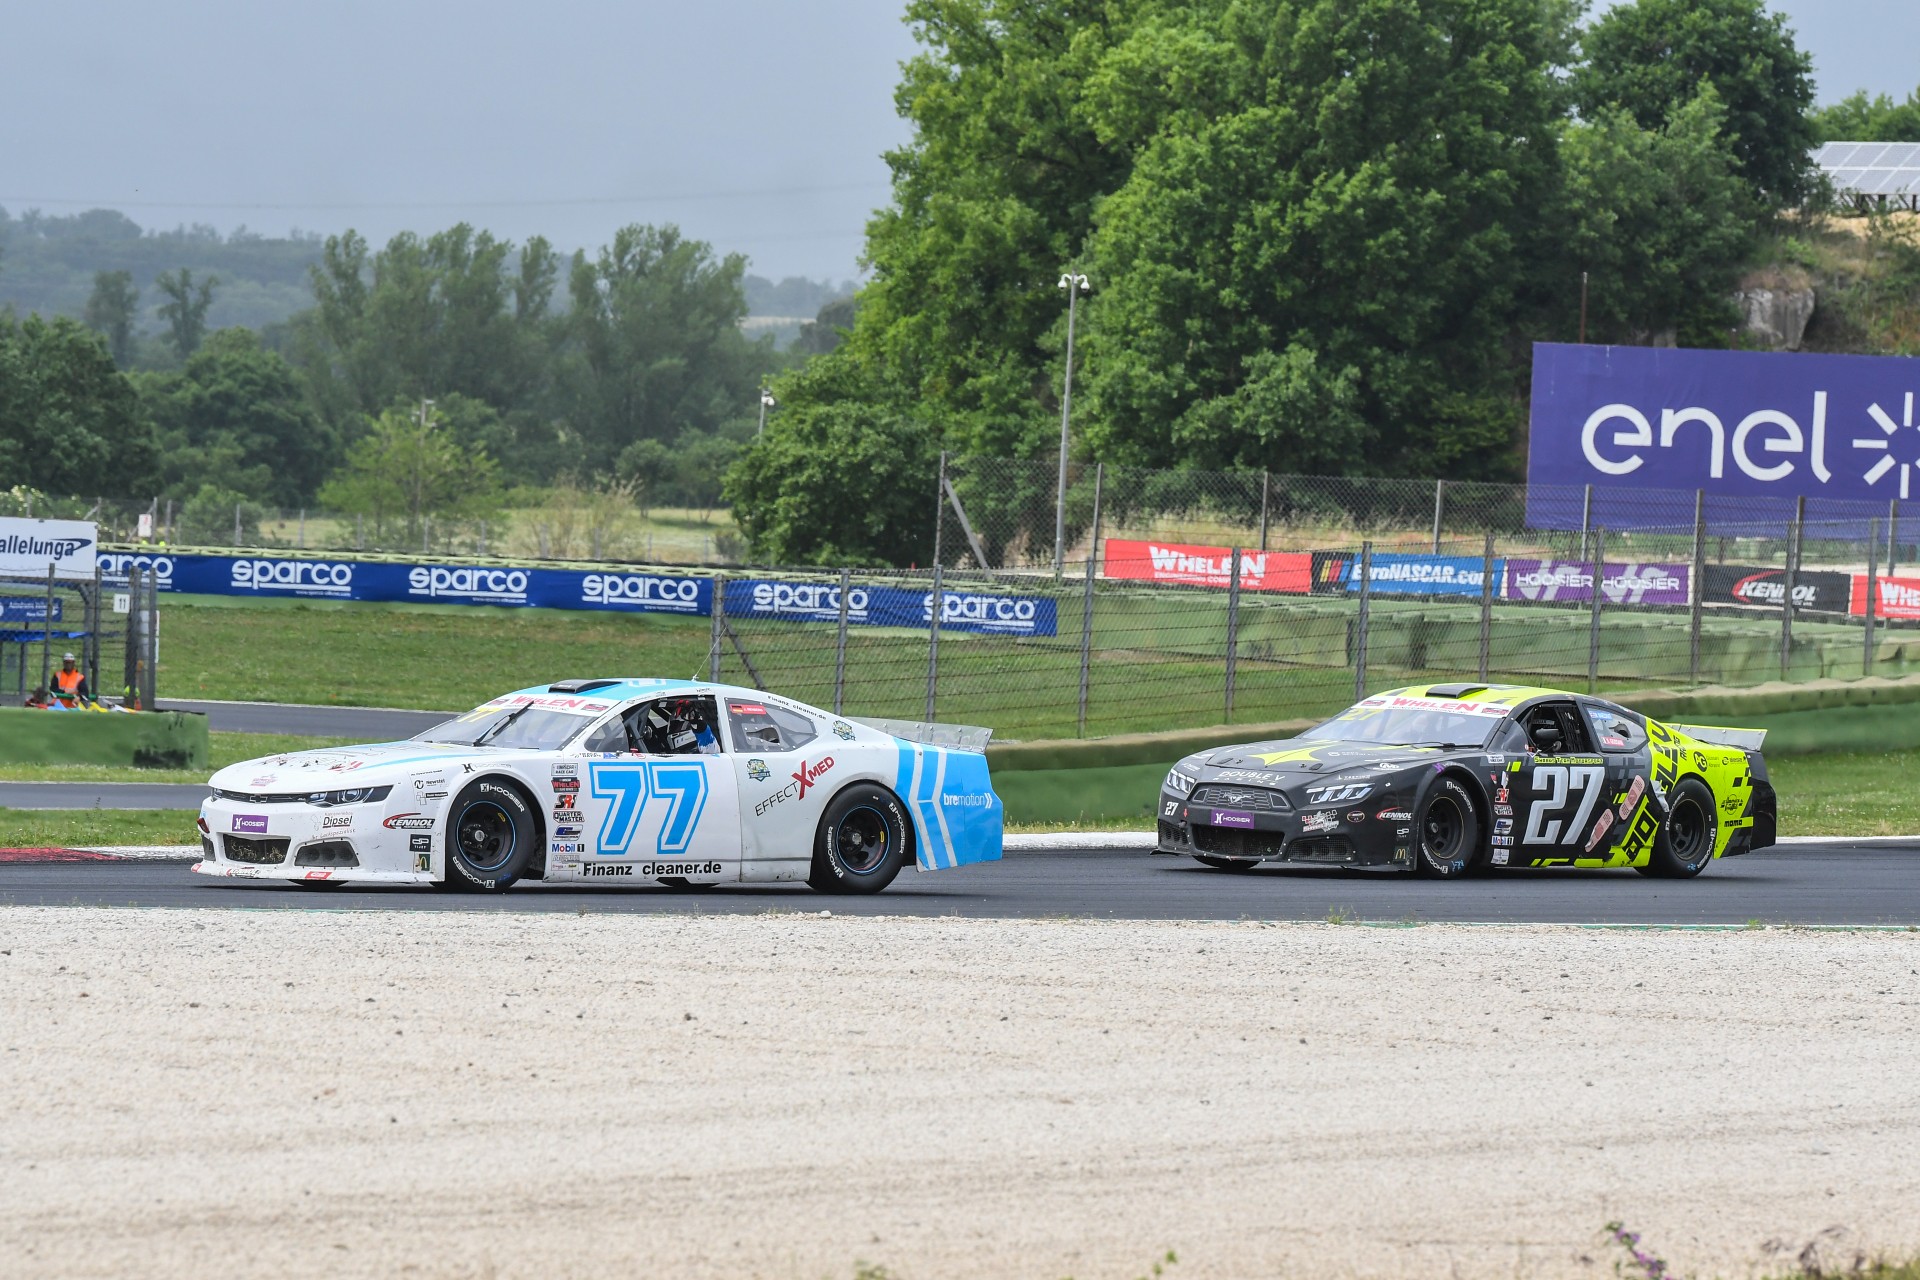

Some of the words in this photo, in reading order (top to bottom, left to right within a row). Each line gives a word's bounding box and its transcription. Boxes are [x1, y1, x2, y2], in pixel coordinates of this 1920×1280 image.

[1581, 391, 1832, 484] enel
[231, 560, 352, 589] sparco
[1149, 546, 1266, 578] WHELEN
[409, 567, 528, 596] sparco
[582, 574, 699, 604] sparco
[1516, 573, 1594, 588] HOOSIER
[1602, 575, 1680, 590] HOOSIER
[1738, 581, 1817, 601] KENOL
[752, 583, 869, 613] sparco
[922, 591, 1036, 623] sparco
[1392, 698, 1479, 711] WHELEN
[489, 785, 525, 813] HOOSIER
[588, 762, 709, 854] 77
[943, 792, 985, 806] bremotion
[1164, 801, 1179, 816] 27
[1522, 766, 1605, 844] 27
[241, 820, 266, 828] HOOSIER
[322, 815, 353, 828] Dipsel
[894, 809, 906, 854] HOOSIER
[1222, 816, 1251, 824] HOOSIER
[552, 843, 576, 852] Mobil
[452, 855, 487, 886] HOOSIER
[583, 862, 633, 877] Finanz
[642, 861, 722, 876] cleaner.de
